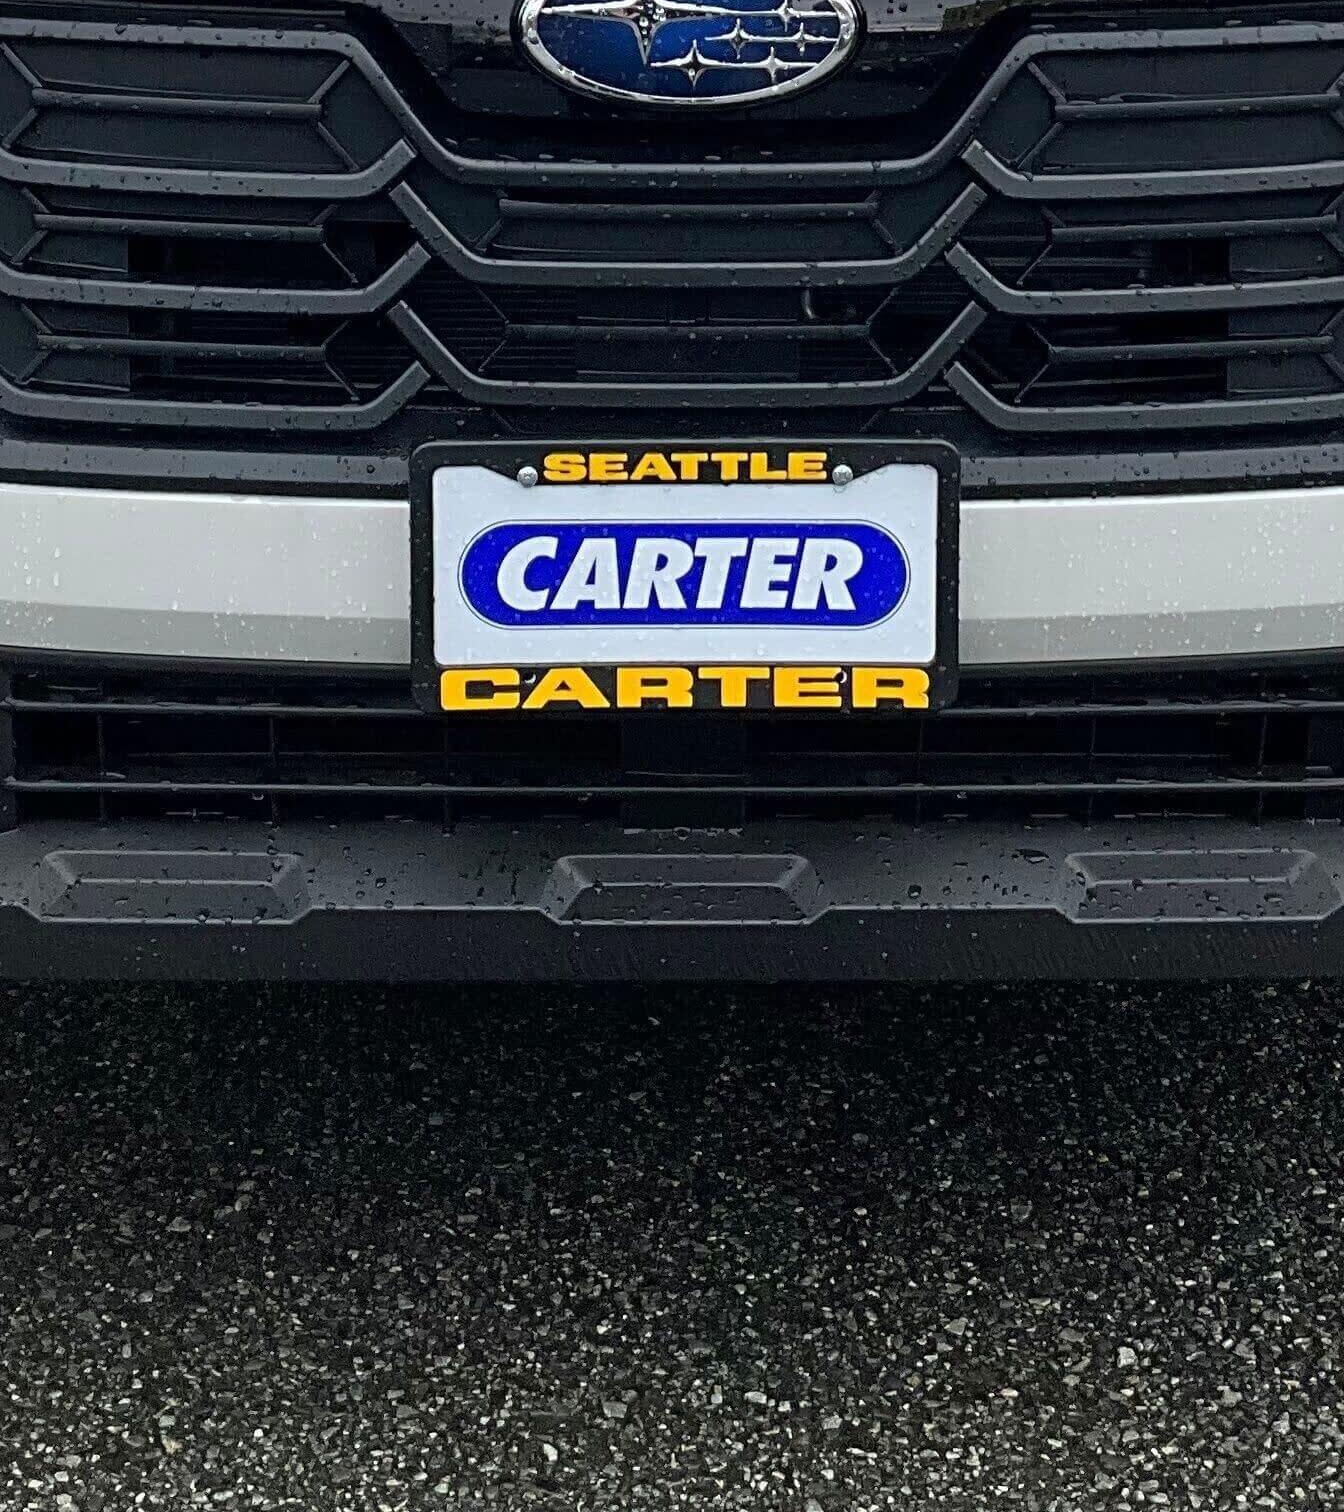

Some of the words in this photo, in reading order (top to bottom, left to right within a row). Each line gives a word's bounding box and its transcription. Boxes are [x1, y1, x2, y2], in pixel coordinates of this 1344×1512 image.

[542, 451, 828, 482] SEATTLE
[496, 536, 864, 612] CARTER
[439, 666, 930, 711] CARTER
